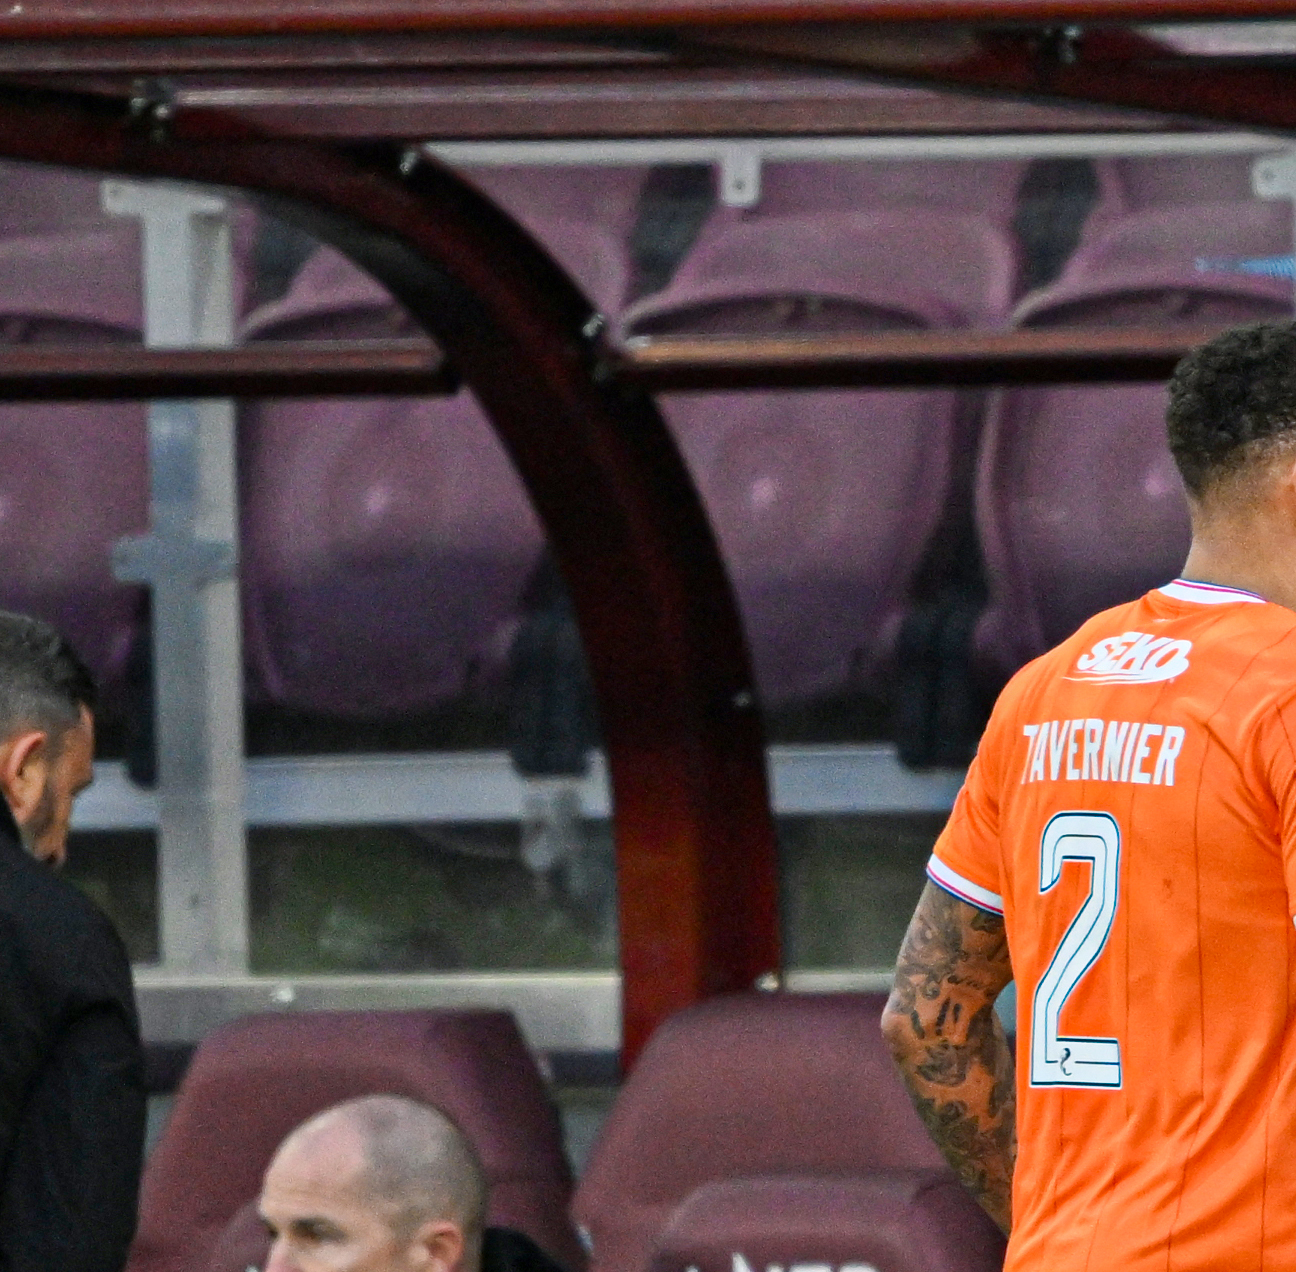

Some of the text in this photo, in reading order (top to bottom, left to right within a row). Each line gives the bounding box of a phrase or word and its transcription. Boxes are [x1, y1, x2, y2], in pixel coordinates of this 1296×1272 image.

[1075, 631, 1193, 680] SEKO
[1020, 718, 1186, 787] TAVERNIER
[1030, 810, 1122, 1089] 2
